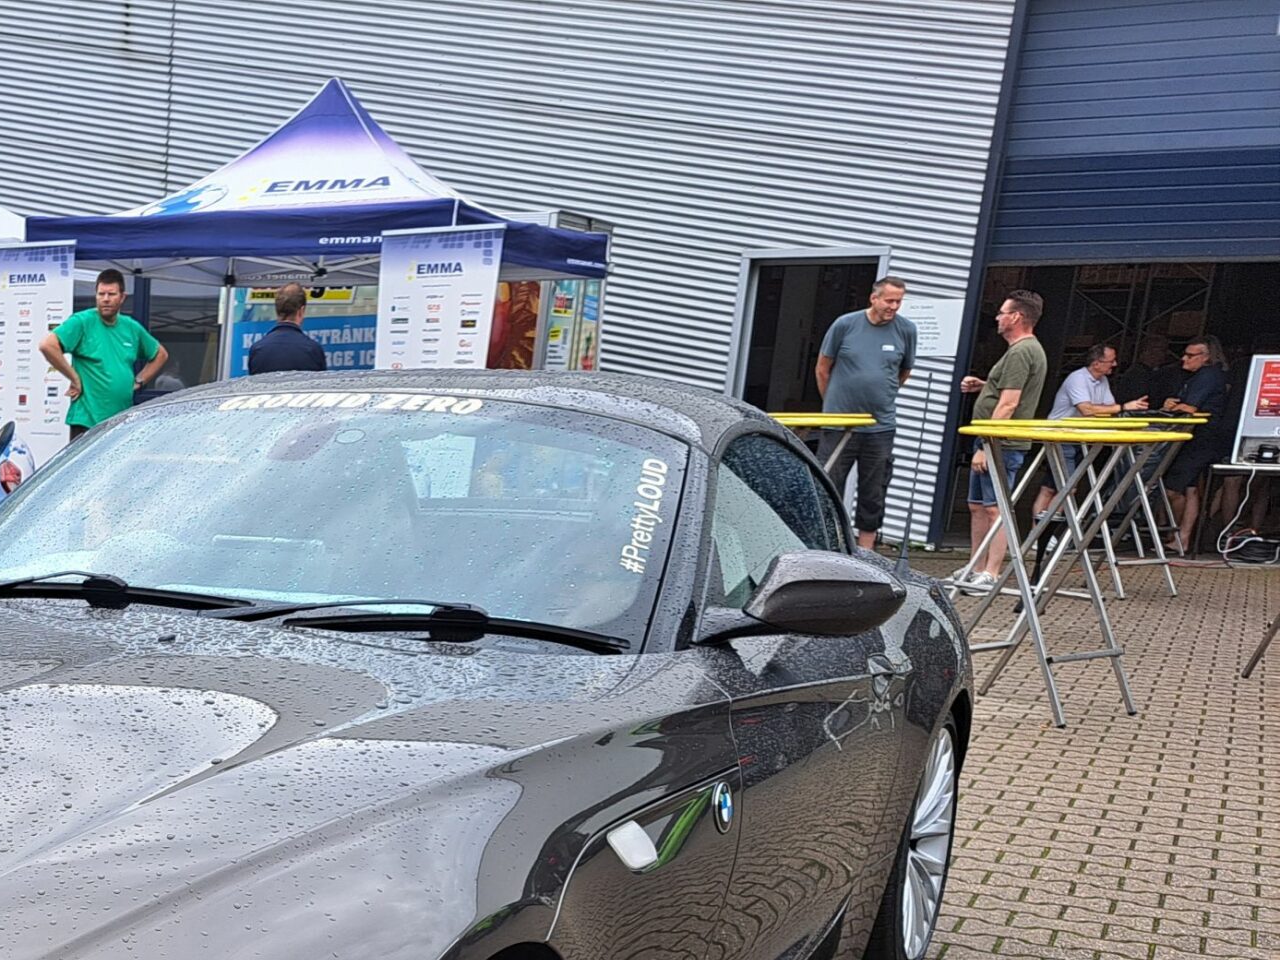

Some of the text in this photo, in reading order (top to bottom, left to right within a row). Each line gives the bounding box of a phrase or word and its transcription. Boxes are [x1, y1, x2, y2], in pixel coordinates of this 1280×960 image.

[265, 176, 391, 193] EMMA
[416, 262, 463, 274] EMMA
[9, 273, 46, 283] EMMA
[218, 392, 483, 415] GROUND ZERO
[620, 459, 668, 574] #PrettyLOUD
